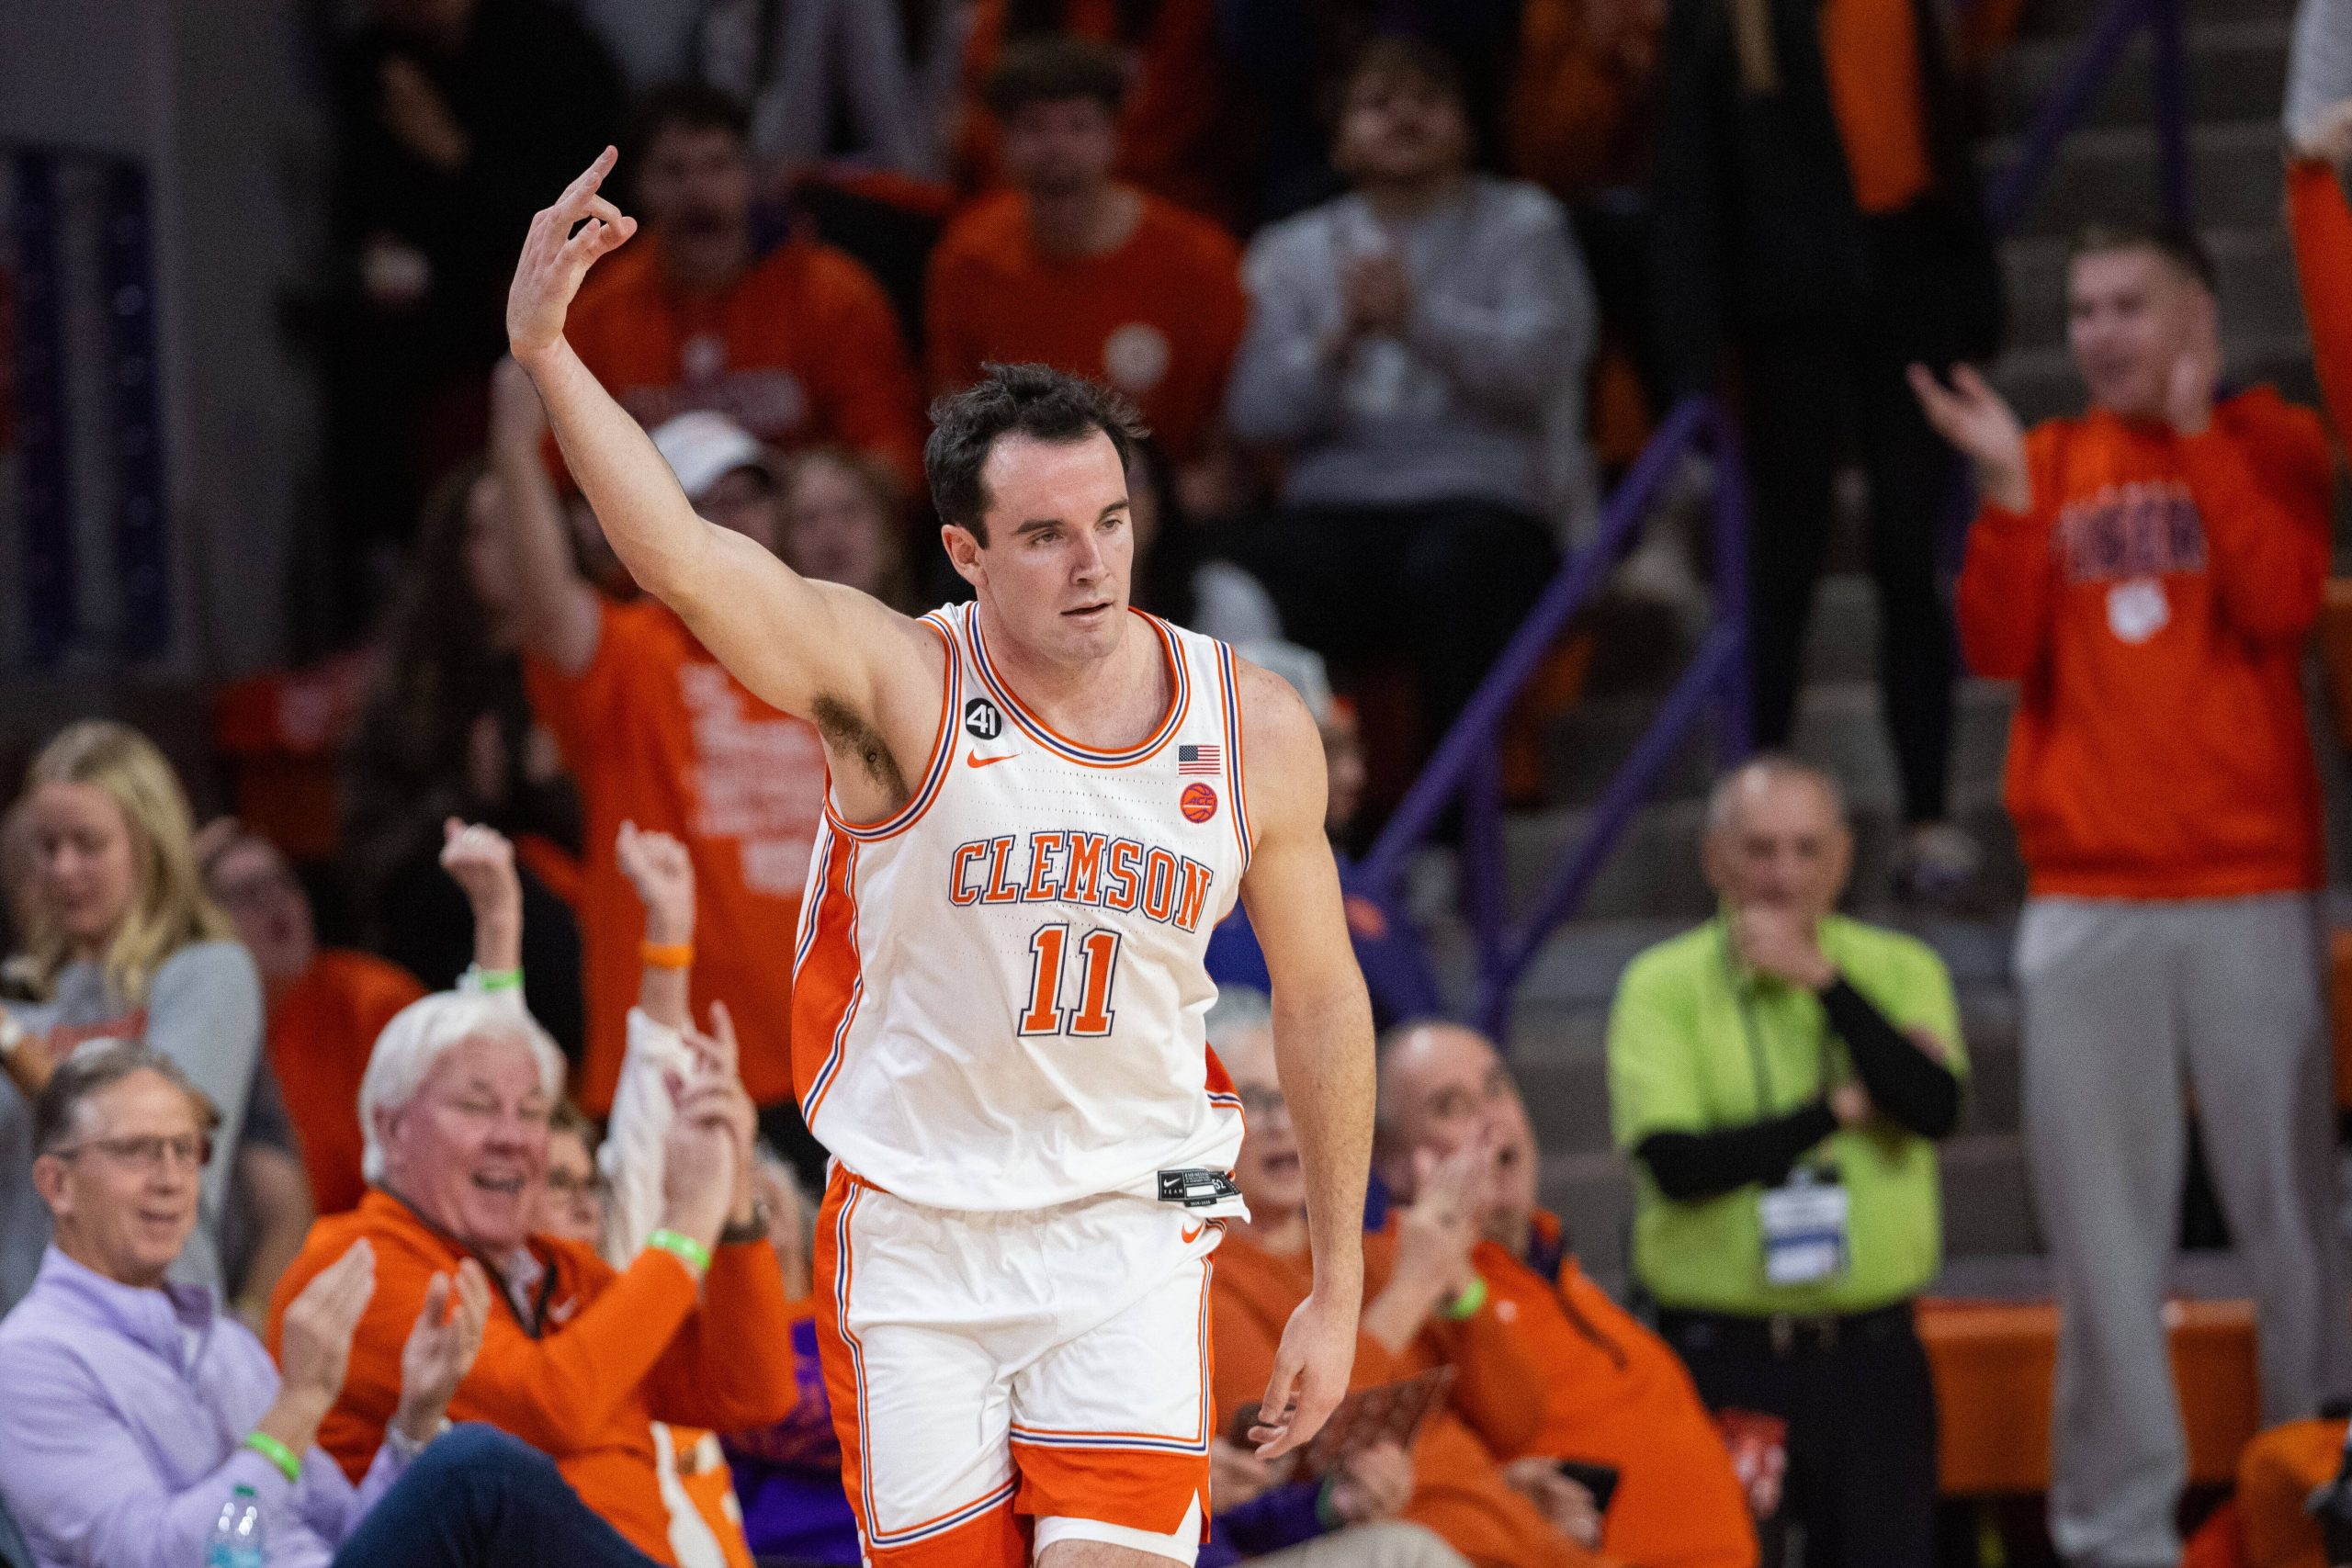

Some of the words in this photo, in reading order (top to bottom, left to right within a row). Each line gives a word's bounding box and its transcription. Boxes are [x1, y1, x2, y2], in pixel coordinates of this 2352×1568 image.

[967, 704, 996, 736] 41
[949, 830, 1214, 933] CLEMSON
[1017, 923, 1122, 1037] 11
